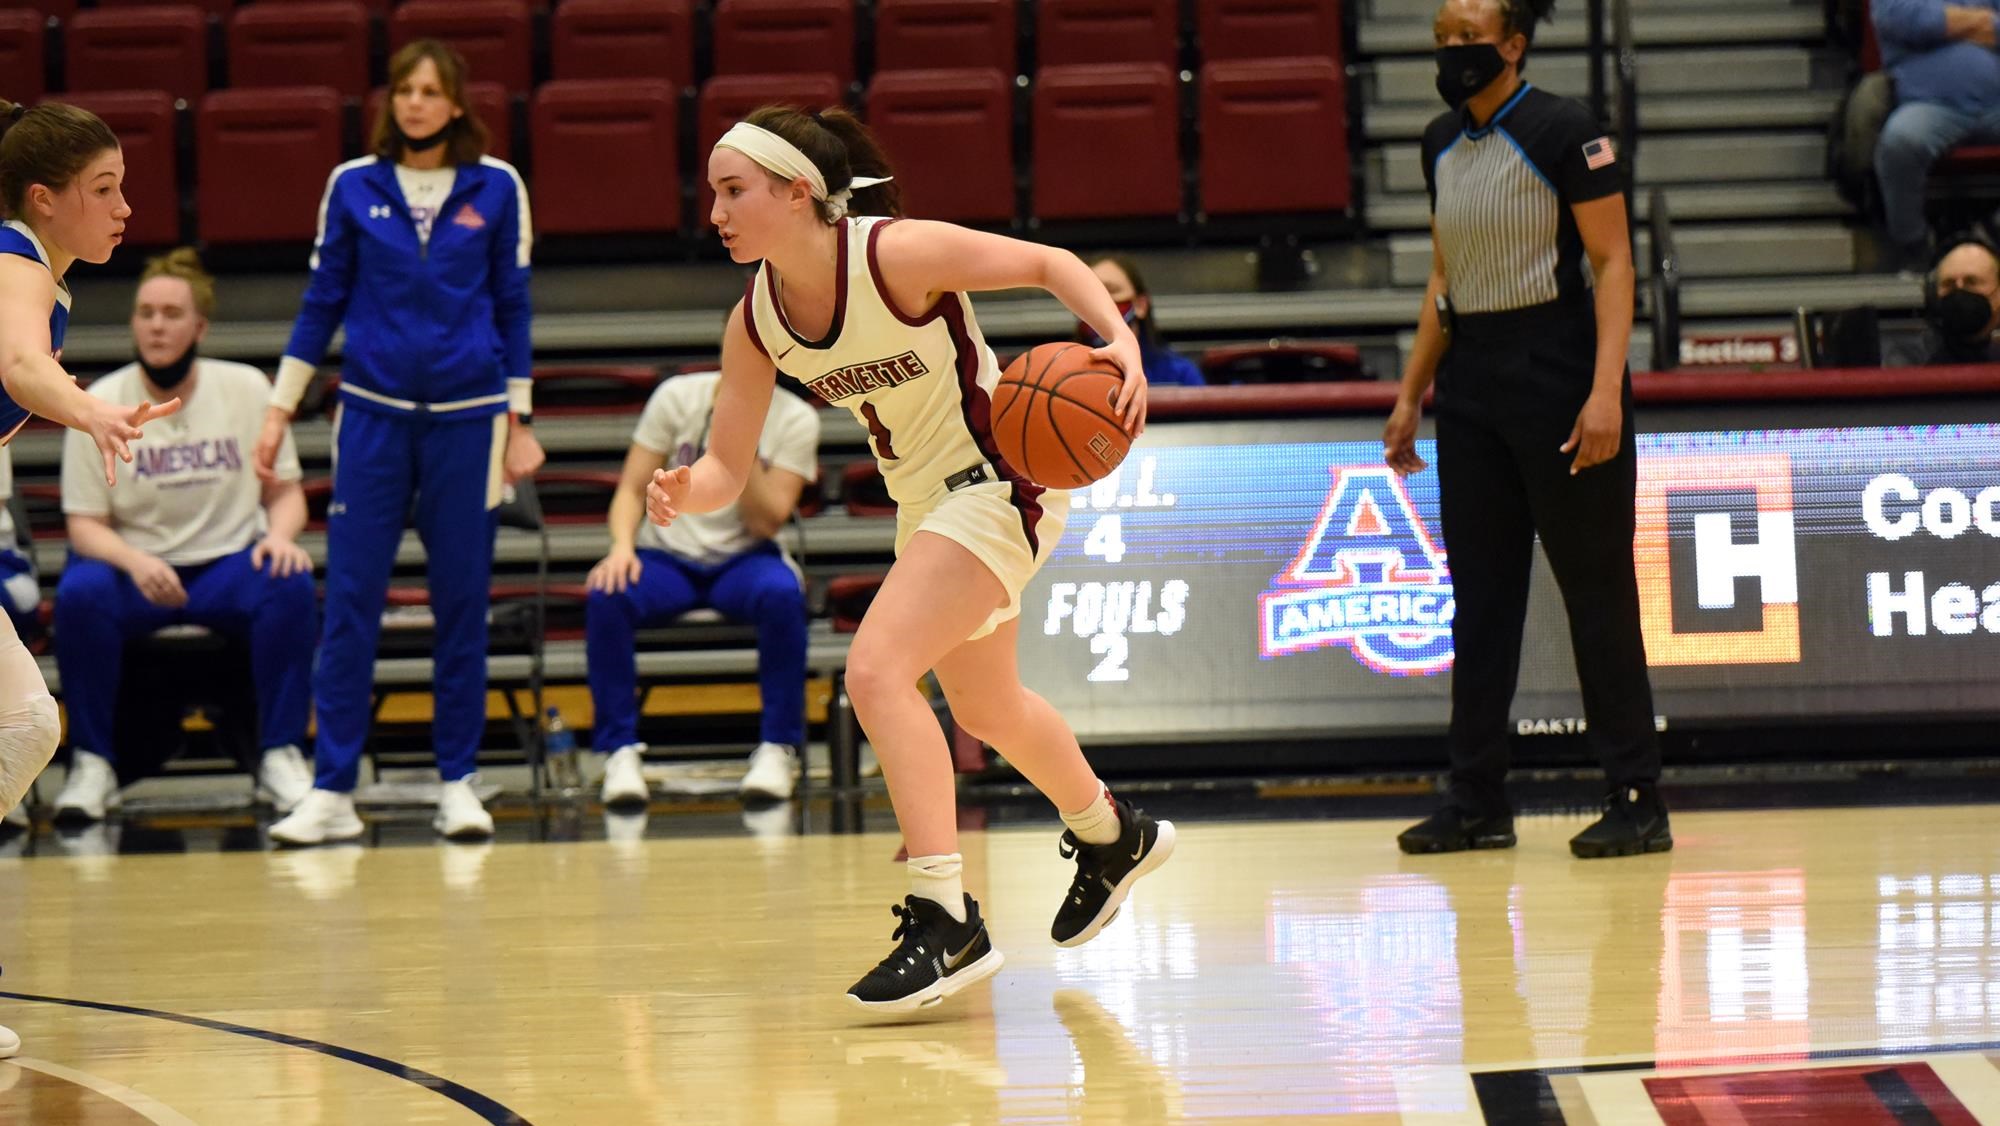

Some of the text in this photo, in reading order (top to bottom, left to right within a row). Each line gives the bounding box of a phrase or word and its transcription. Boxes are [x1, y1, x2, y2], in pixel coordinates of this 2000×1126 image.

[1680, 338, 1775, 363] Section
[860, 400, 900, 460] 1
[132, 437, 243, 483] AMERICAN
[1084, 514, 1126, 563] 4
[1044, 579, 1189, 637] FOULS
[1278, 593, 1456, 637] AMERICA
[1087, 633, 1129, 682] 2
